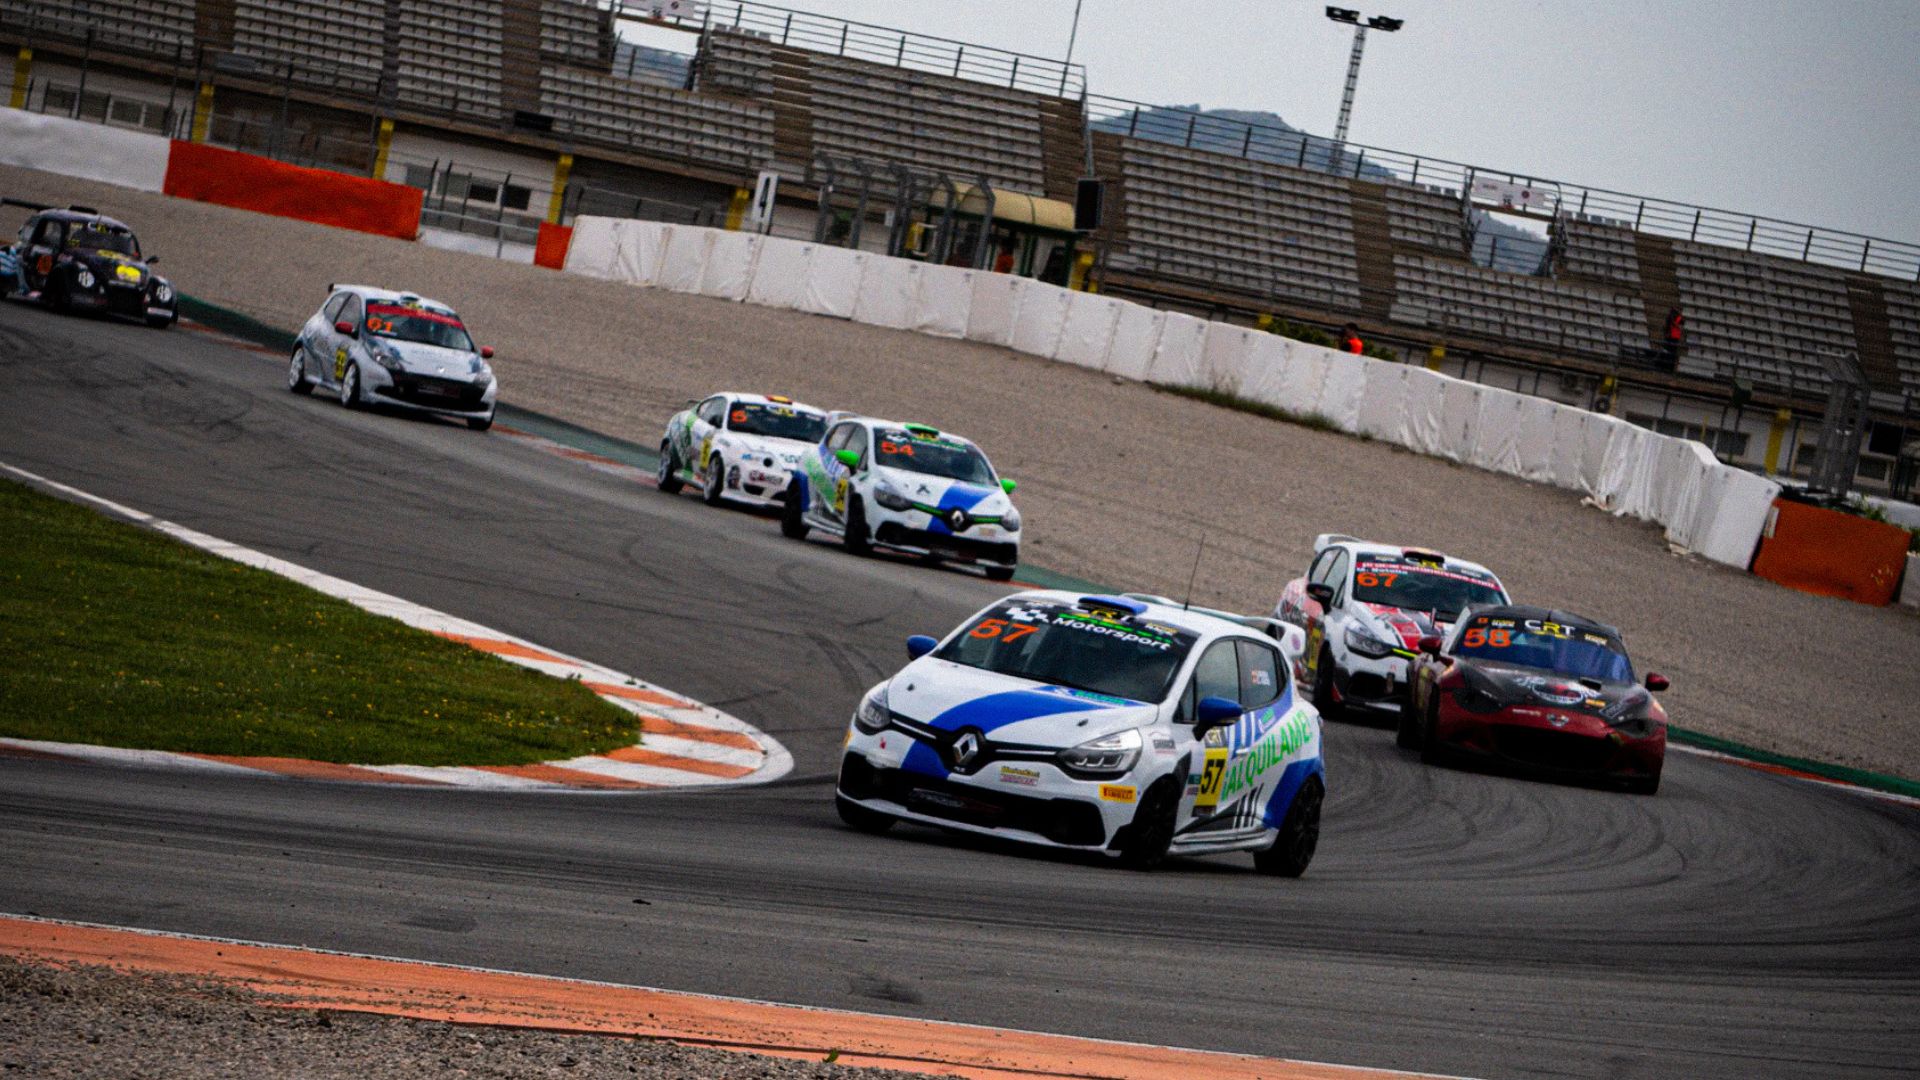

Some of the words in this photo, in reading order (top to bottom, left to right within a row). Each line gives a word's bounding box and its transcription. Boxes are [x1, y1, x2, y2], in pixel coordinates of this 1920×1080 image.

[1357, 571, 1399, 588] 67
[968, 618, 1040, 644] 57
[1052, 616, 1172, 651] Motorsport
[1463, 627, 1512, 648] 58
[1524, 618, 1576, 637] CRT
[1201, 758, 1226, 795] 57
